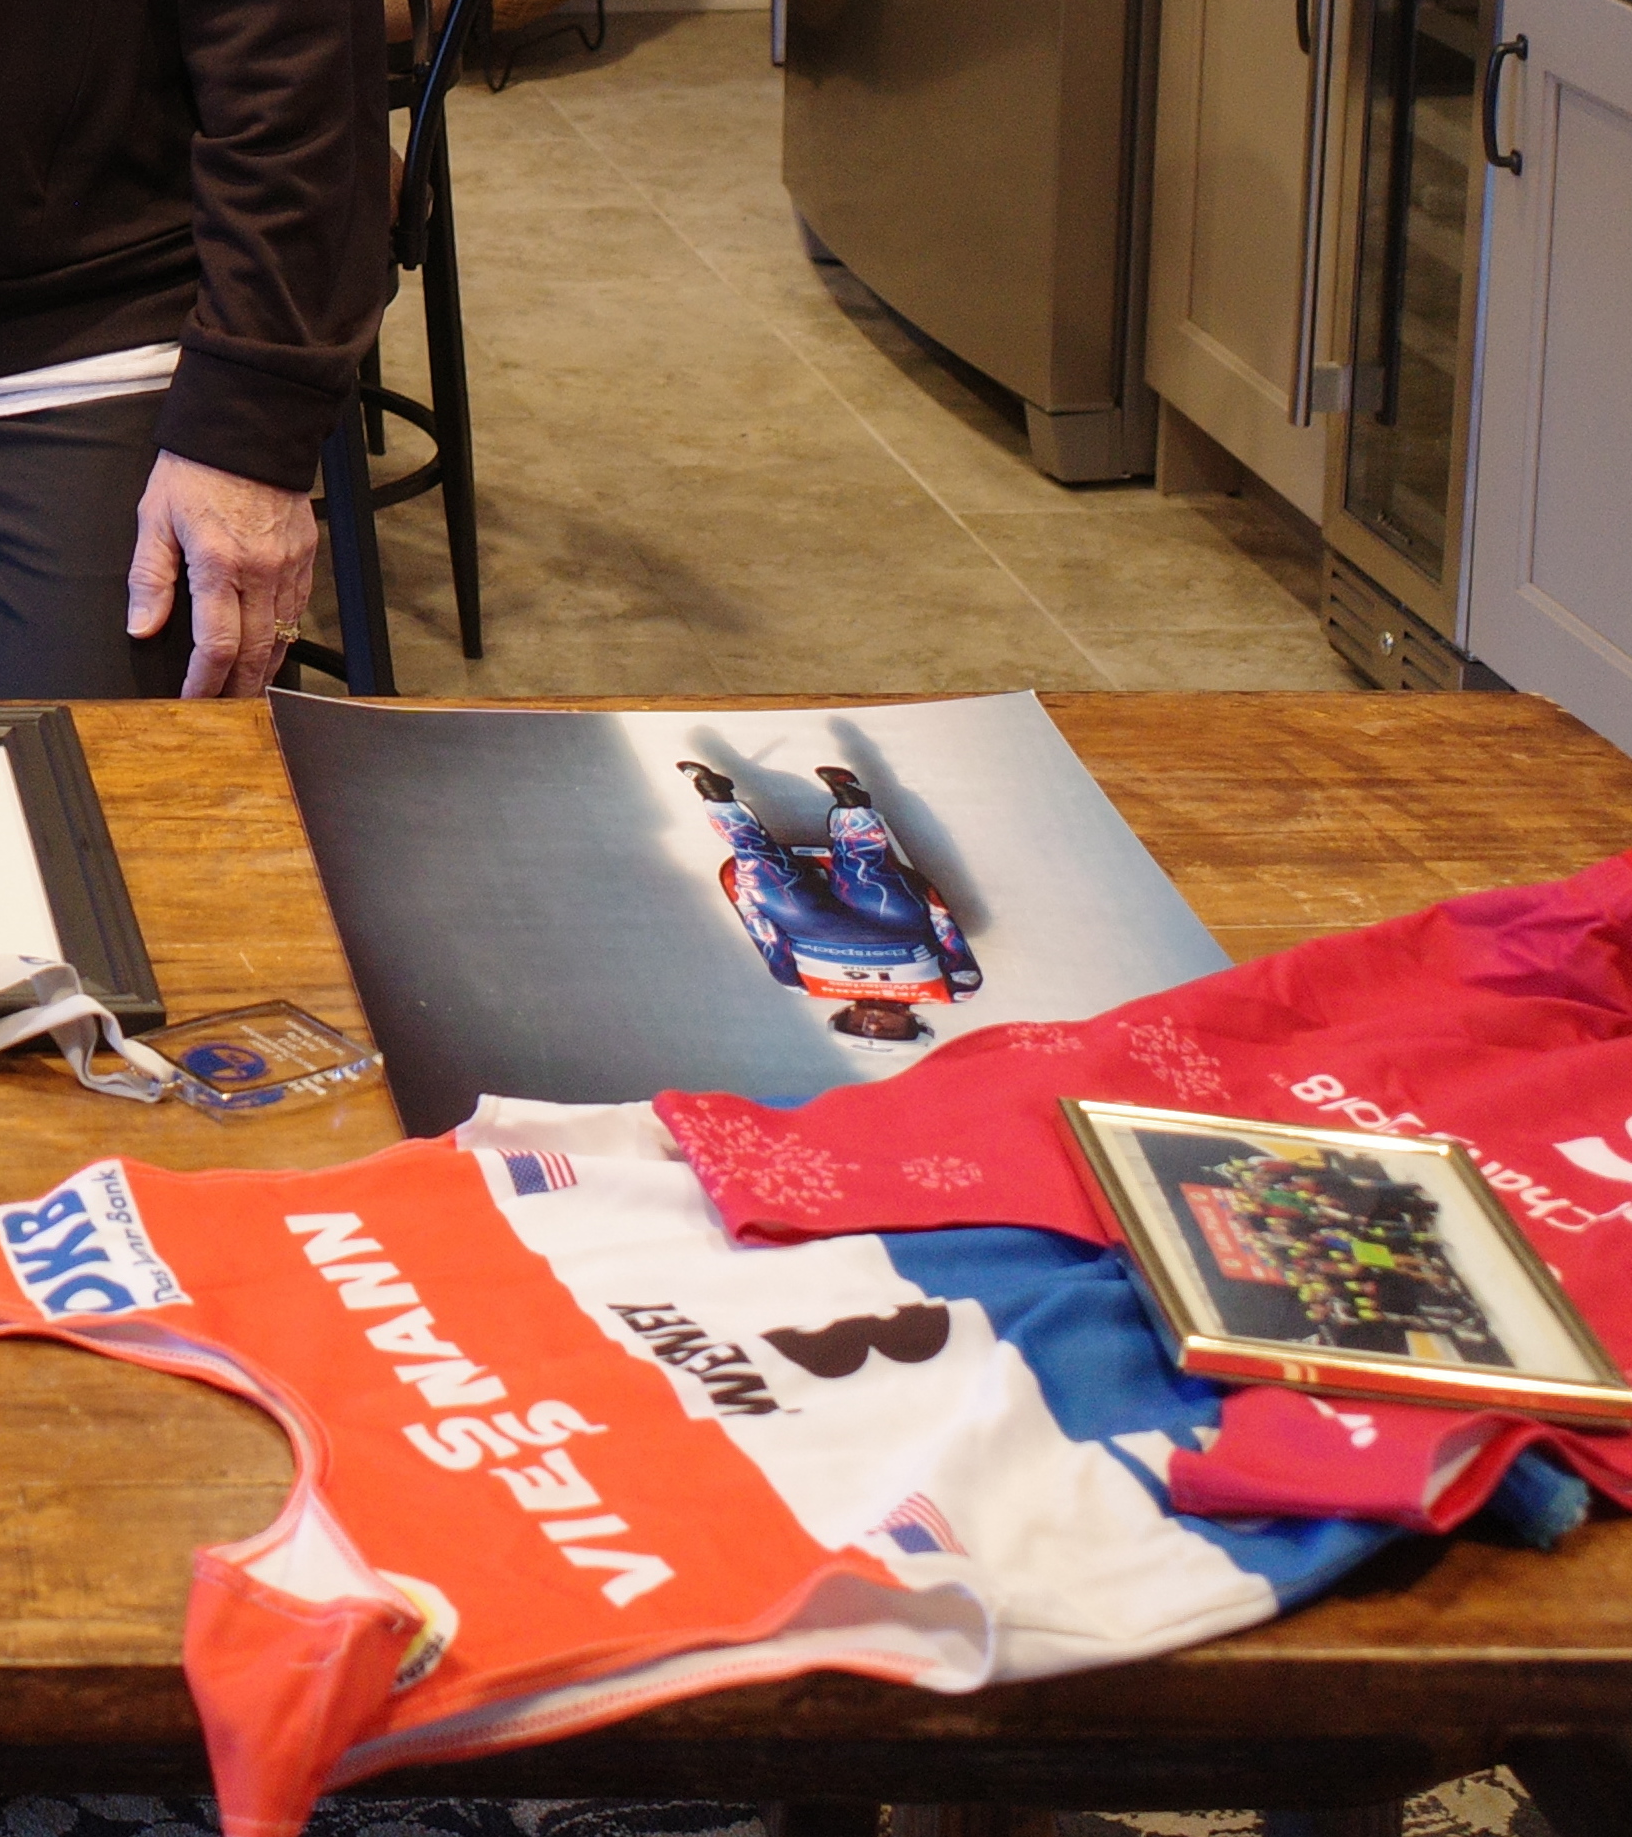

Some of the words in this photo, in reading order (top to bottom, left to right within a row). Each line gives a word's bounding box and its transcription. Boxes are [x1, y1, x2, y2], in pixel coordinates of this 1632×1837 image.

[102, 1168, 135, 1238] Bank
[1, 1187, 139, 1316] DKB
[151, 1252, 182, 1304] Das
